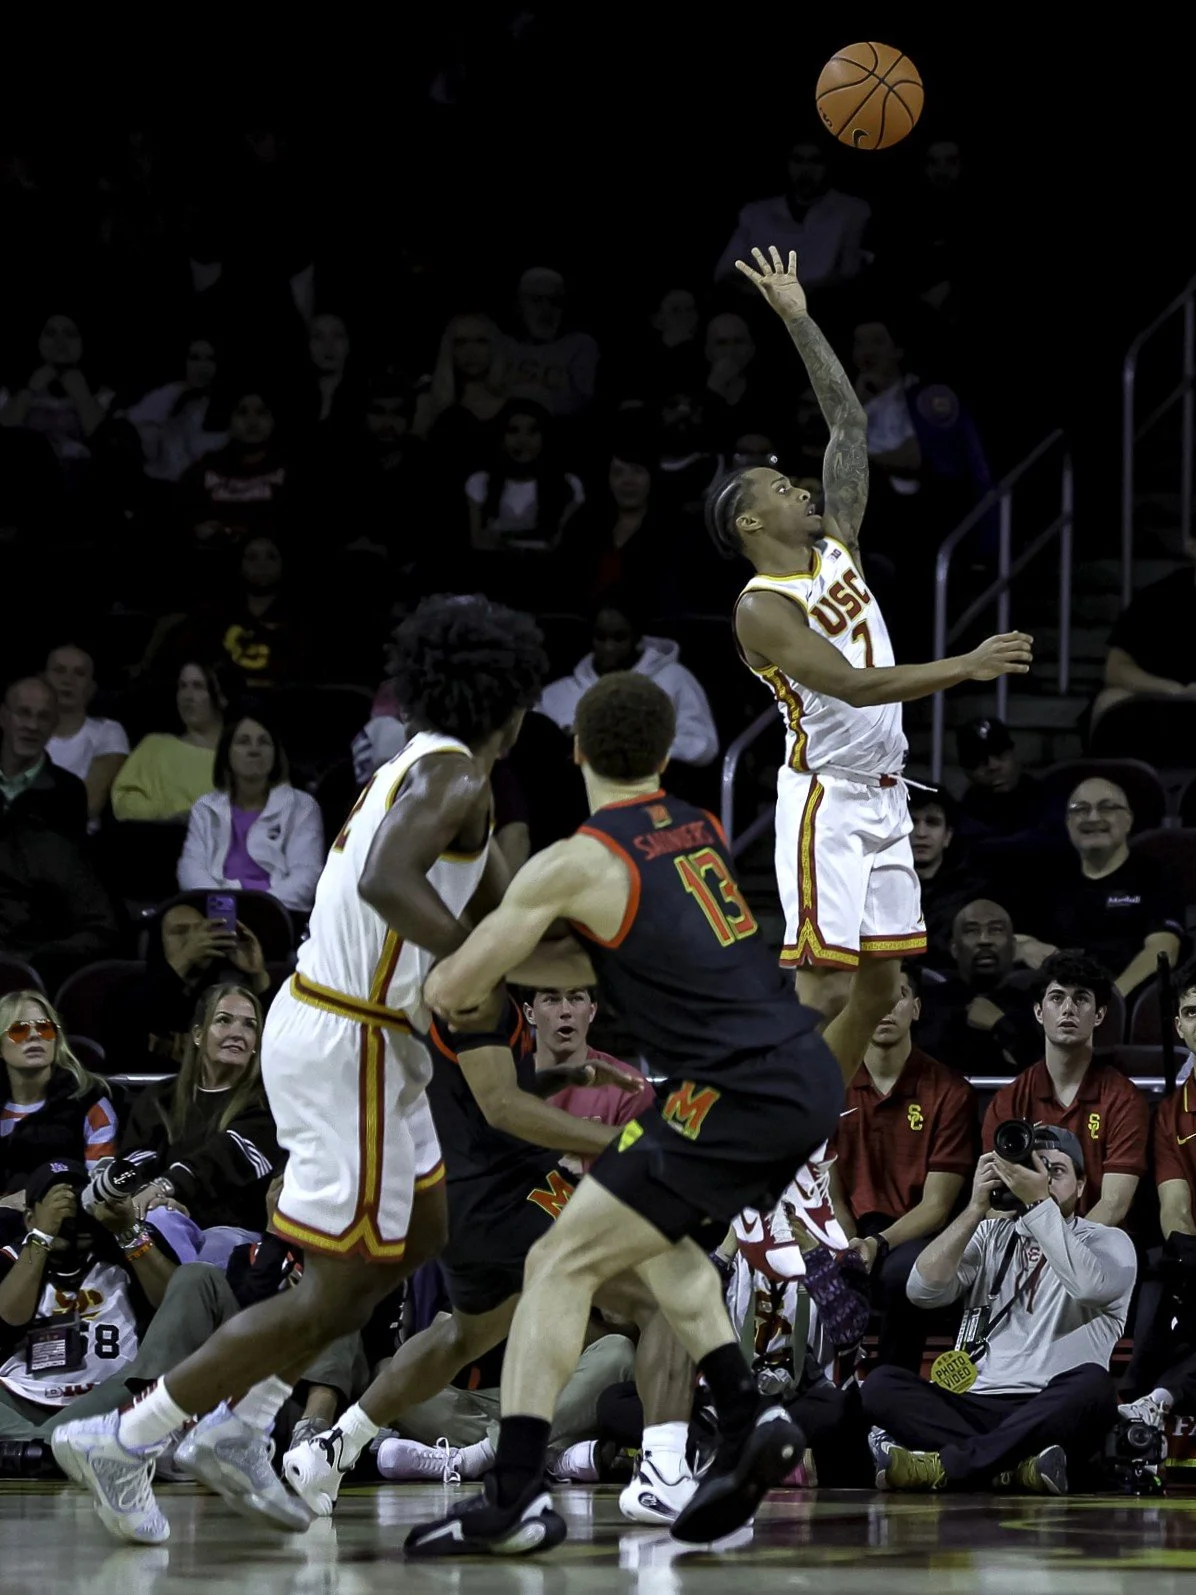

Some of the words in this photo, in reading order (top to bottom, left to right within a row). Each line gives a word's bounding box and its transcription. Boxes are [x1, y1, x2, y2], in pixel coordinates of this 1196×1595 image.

[809, 567, 871, 637] USC
[851, 617, 876, 668] 7
[673, 846, 758, 948] 13
[661, 1076, 721, 1141] M
[935, 1355, 967, 1380] PHOTO
[943, 1366, 972, 1388] VIDEO
